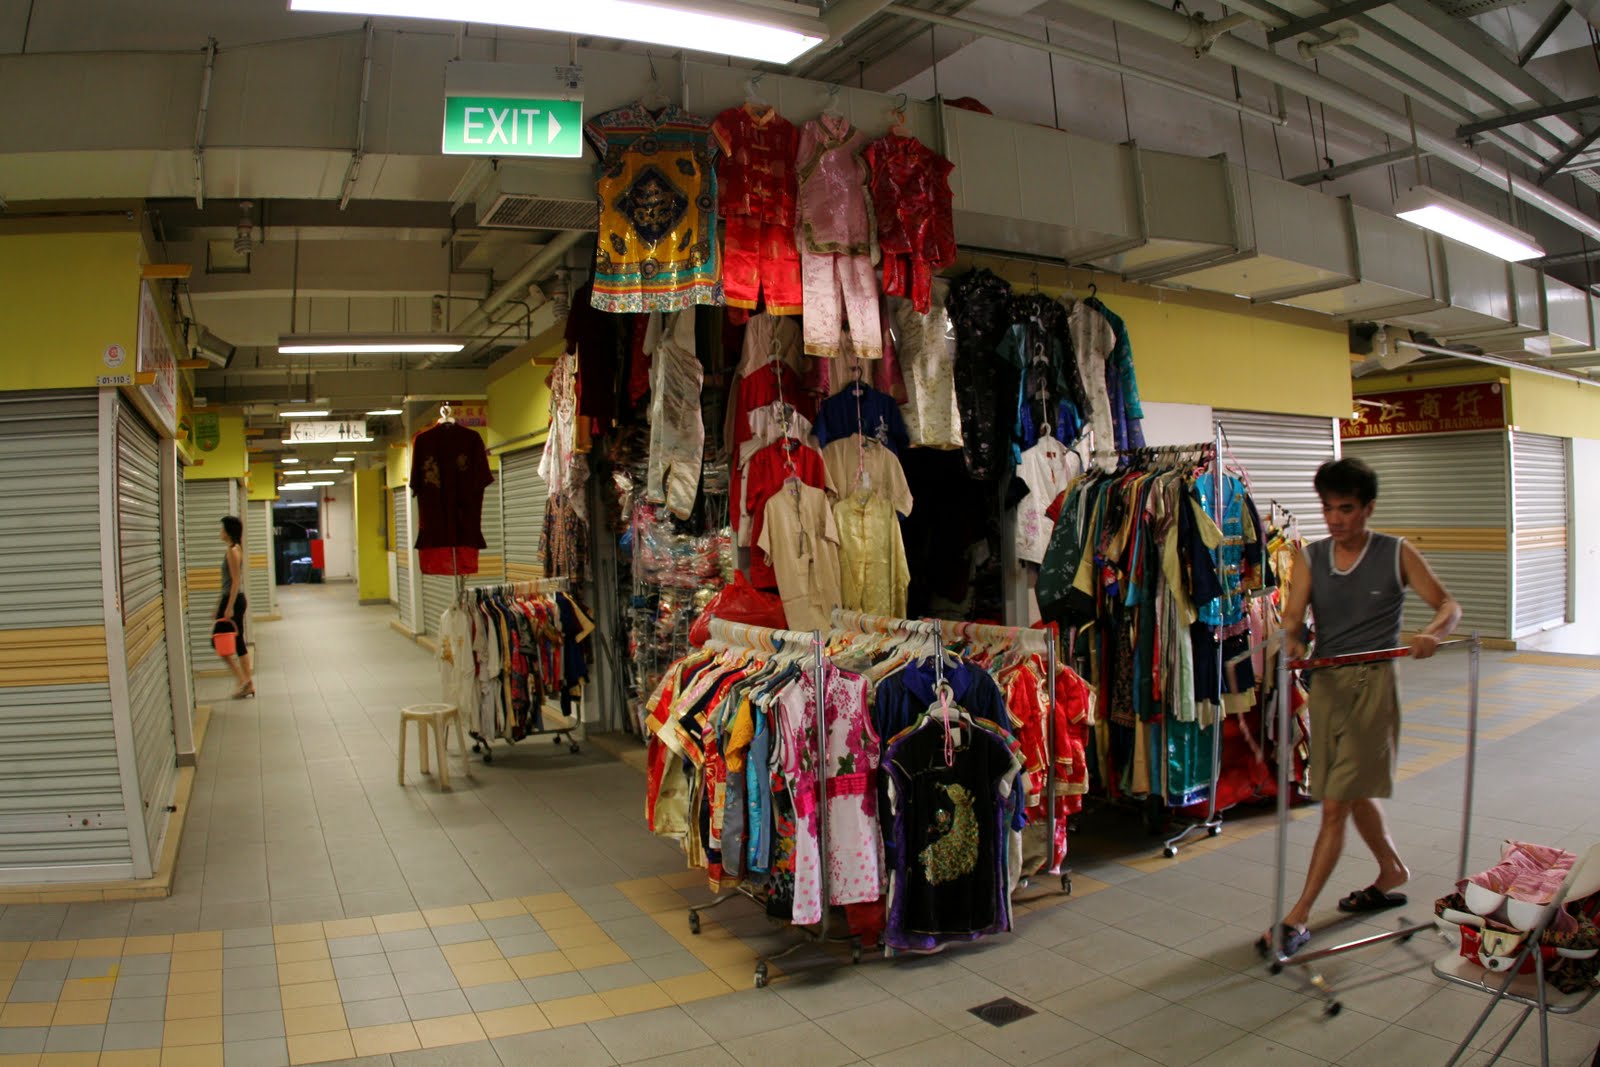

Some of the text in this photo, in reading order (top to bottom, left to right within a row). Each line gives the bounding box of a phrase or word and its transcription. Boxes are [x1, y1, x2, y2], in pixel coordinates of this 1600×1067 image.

[463, 107, 541, 145] EXIT
[102, 376, 125, 384] 01-110
[1364, 423, 1392, 435] JIANG
[1396, 419, 1433, 432] SUNDRY
[1439, 416, 1483, 430] TRADING
